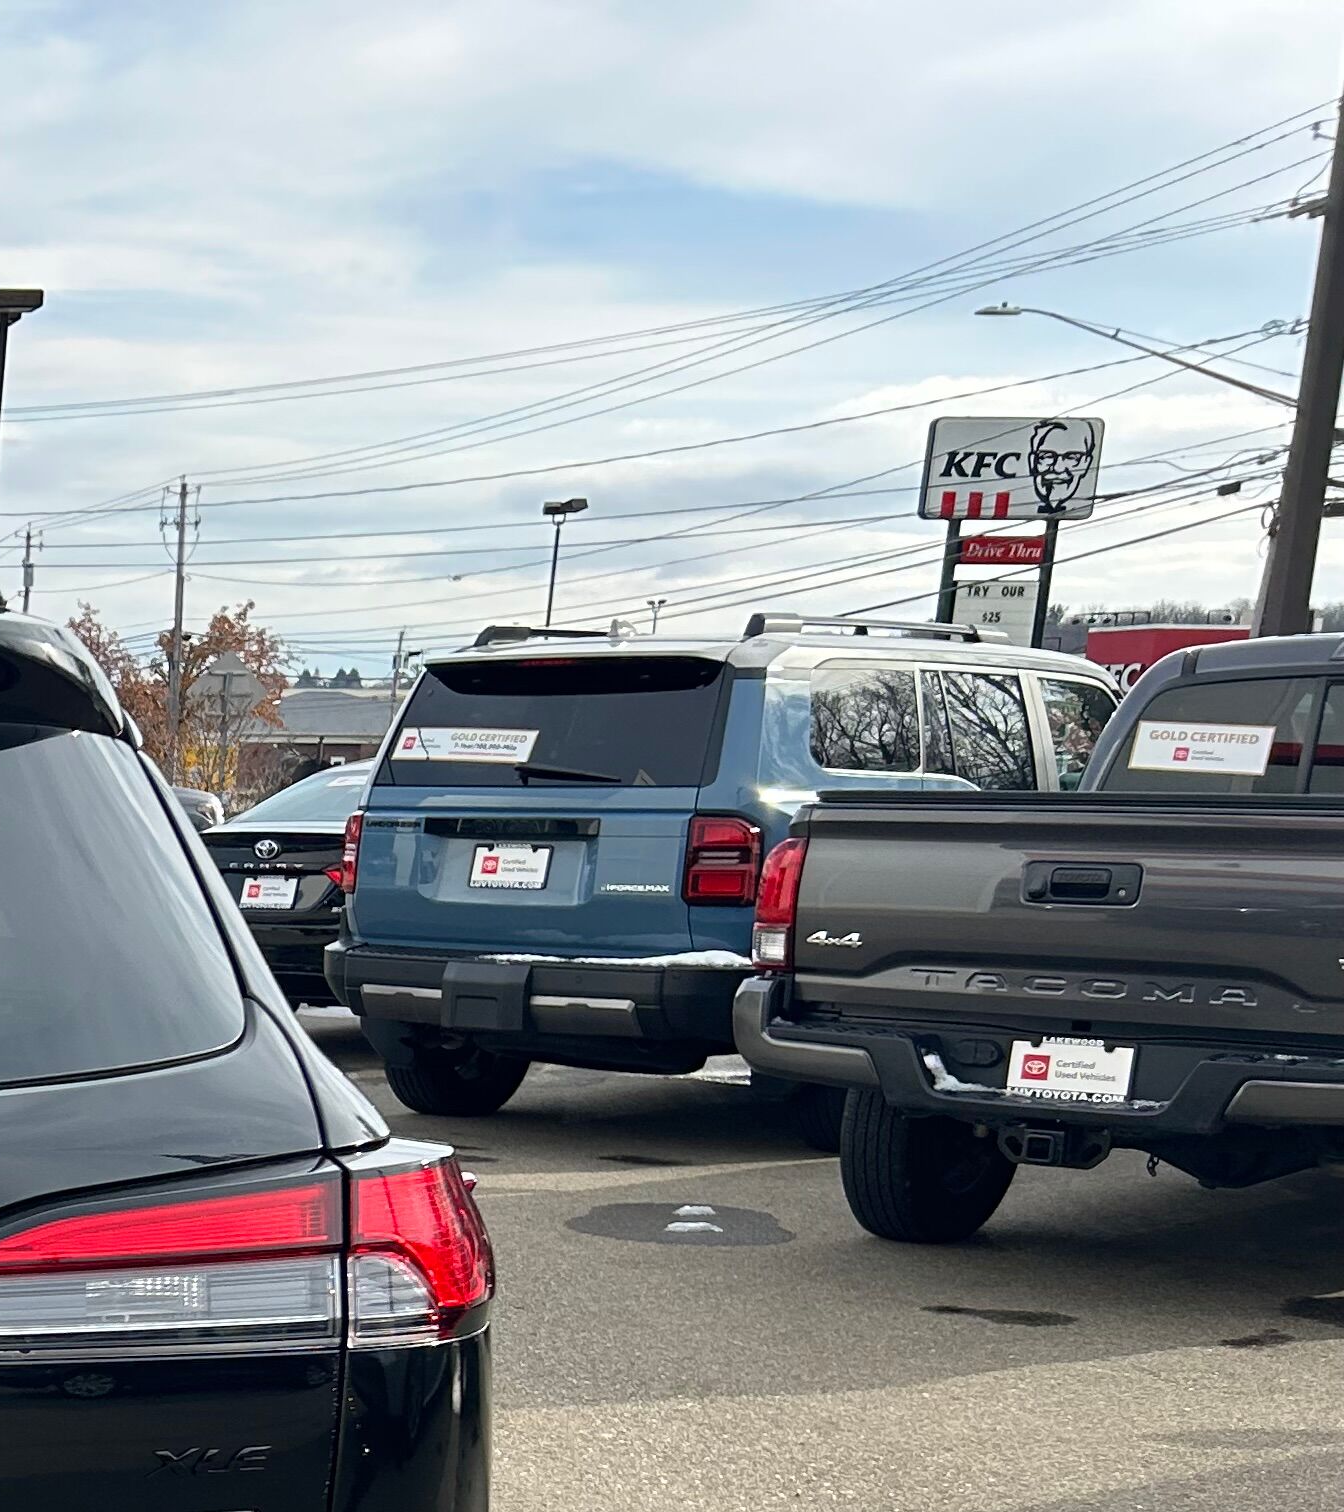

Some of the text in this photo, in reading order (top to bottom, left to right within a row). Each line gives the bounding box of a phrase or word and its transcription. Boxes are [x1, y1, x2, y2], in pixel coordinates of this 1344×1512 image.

[940, 451, 1021, 478] KFC
[966, 542, 1042, 558] Drive Thru
[967, 585, 1025, 597] TRY OUR
[982, 611, 1001, 623] $25
[1103, 663, 1142, 693] FC
[450, 732, 528, 744] GOLD CERTIFIED
[1149, 729, 1260, 745] GOLD CERTIFIED
[910, 967, 1259, 1007] TACOMA
[1042, 1036, 1105, 1047] LAKEWOOD
[1056, 1060, 1096, 1069] Certified
[1054, 1071, 1116, 1082] Used Vehicles
[144, 1445, 273, 1479] XLE
